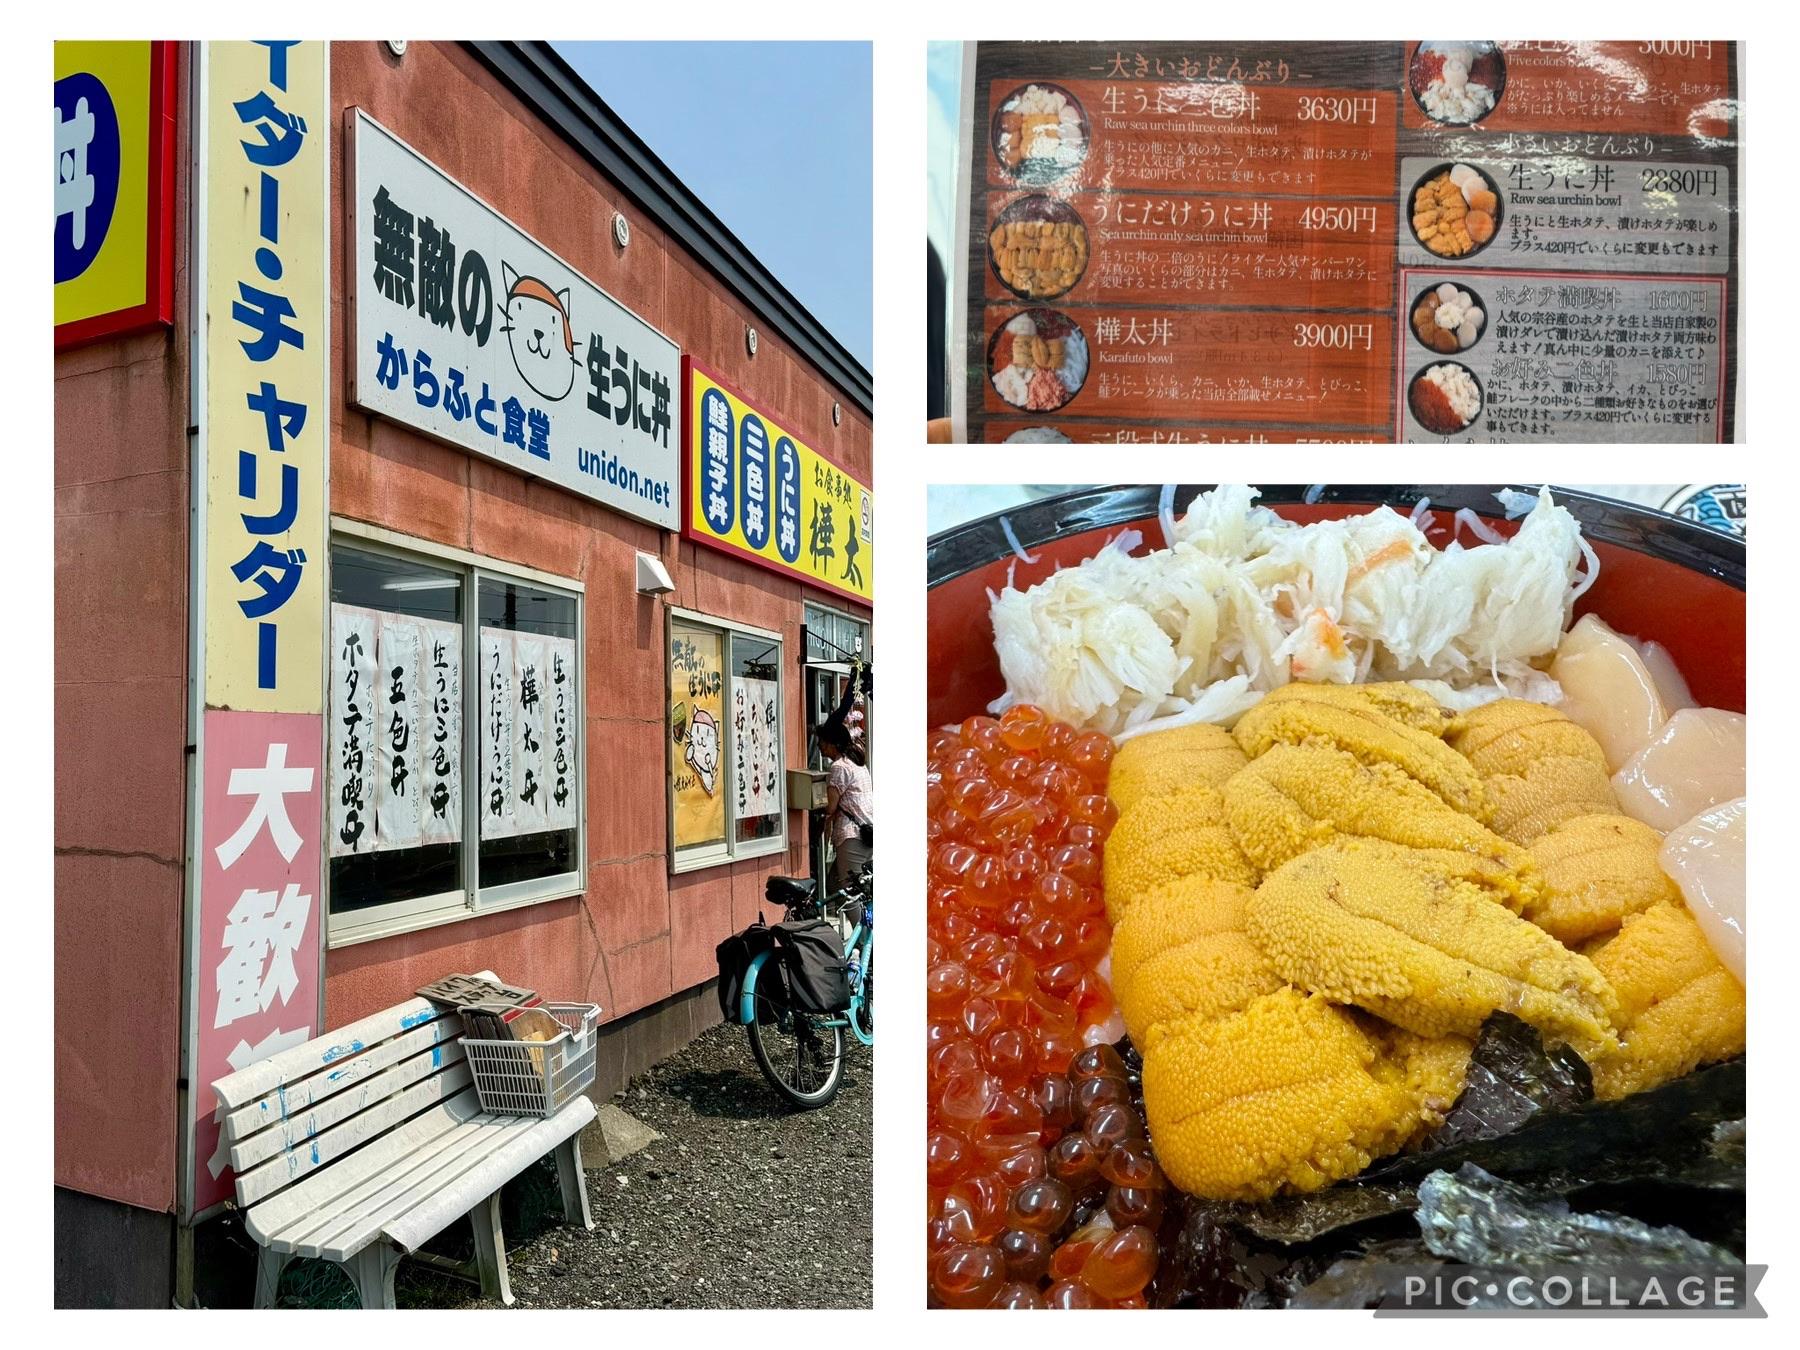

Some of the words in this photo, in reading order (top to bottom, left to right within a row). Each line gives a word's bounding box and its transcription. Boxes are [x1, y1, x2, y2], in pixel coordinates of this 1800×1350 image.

[1507, 53, 1531, 66] Five
[1104, 118, 1128, 130] Raw
[1129, 121, 1148, 130] sea
[1149, 119, 1186, 131] urchin
[1187, 121, 1216, 133] three
[1217, 122, 1251, 135] colors
[1252, 123, 1279, 136] bowl
[1296, 96, 1377, 125] 3630円
[1508, 163, 1615, 193] 生うに丼
[1641, 168, 1717, 196] 2880円
[1092, 200, 1273, 228] うにだけうに丼
[1298, 205, 1377, 233] 4950円
[1511, 193, 1536, 205] Raw
[1537, 196, 1555, 205] sea
[1556, 194, 1595, 206] urchin
[1596, 195, 1622, 207] bowl
[1099, 228, 1120, 240] Sea
[1121, 229, 1158, 241] urchin
[1159, 230, 1184, 244] only
[1186, 232, 1203, 242] sea
[1204, 231, 1240, 243] urchin
[1242, 232, 1269, 244] bowl
[1495, 285, 1622, 311] ホタテ満喫丼
[1648, 290, 1708, 312] 1600円
[372, 184, 492, 348] 無敵の
[587, 332, 671, 448] 生うに丼
[1095, 316, 1174, 347] 樺太丼
[1293, 322, 1373, 351] 3900円
[1099, 351, 1146, 364] Karafuto
[1147, 351, 1173, 364] bowl
[1491, 357, 1618, 384] お好み二色丼
[1648, 363, 1707, 385] 1580円
[376, 331, 551, 461] からふと食堂
[578, 446, 670, 508] unidon.net
[708, 394, 728, 526] 鮭親子丼
[746, 420, 764, 541] 三色丼
[780, 443, 796, 554] うに丼
[809, 498, 863, 590] 樺太
[389, 666, 409, 797] 五色丼
[430, 639, 451, 819] 生うに三色丼
